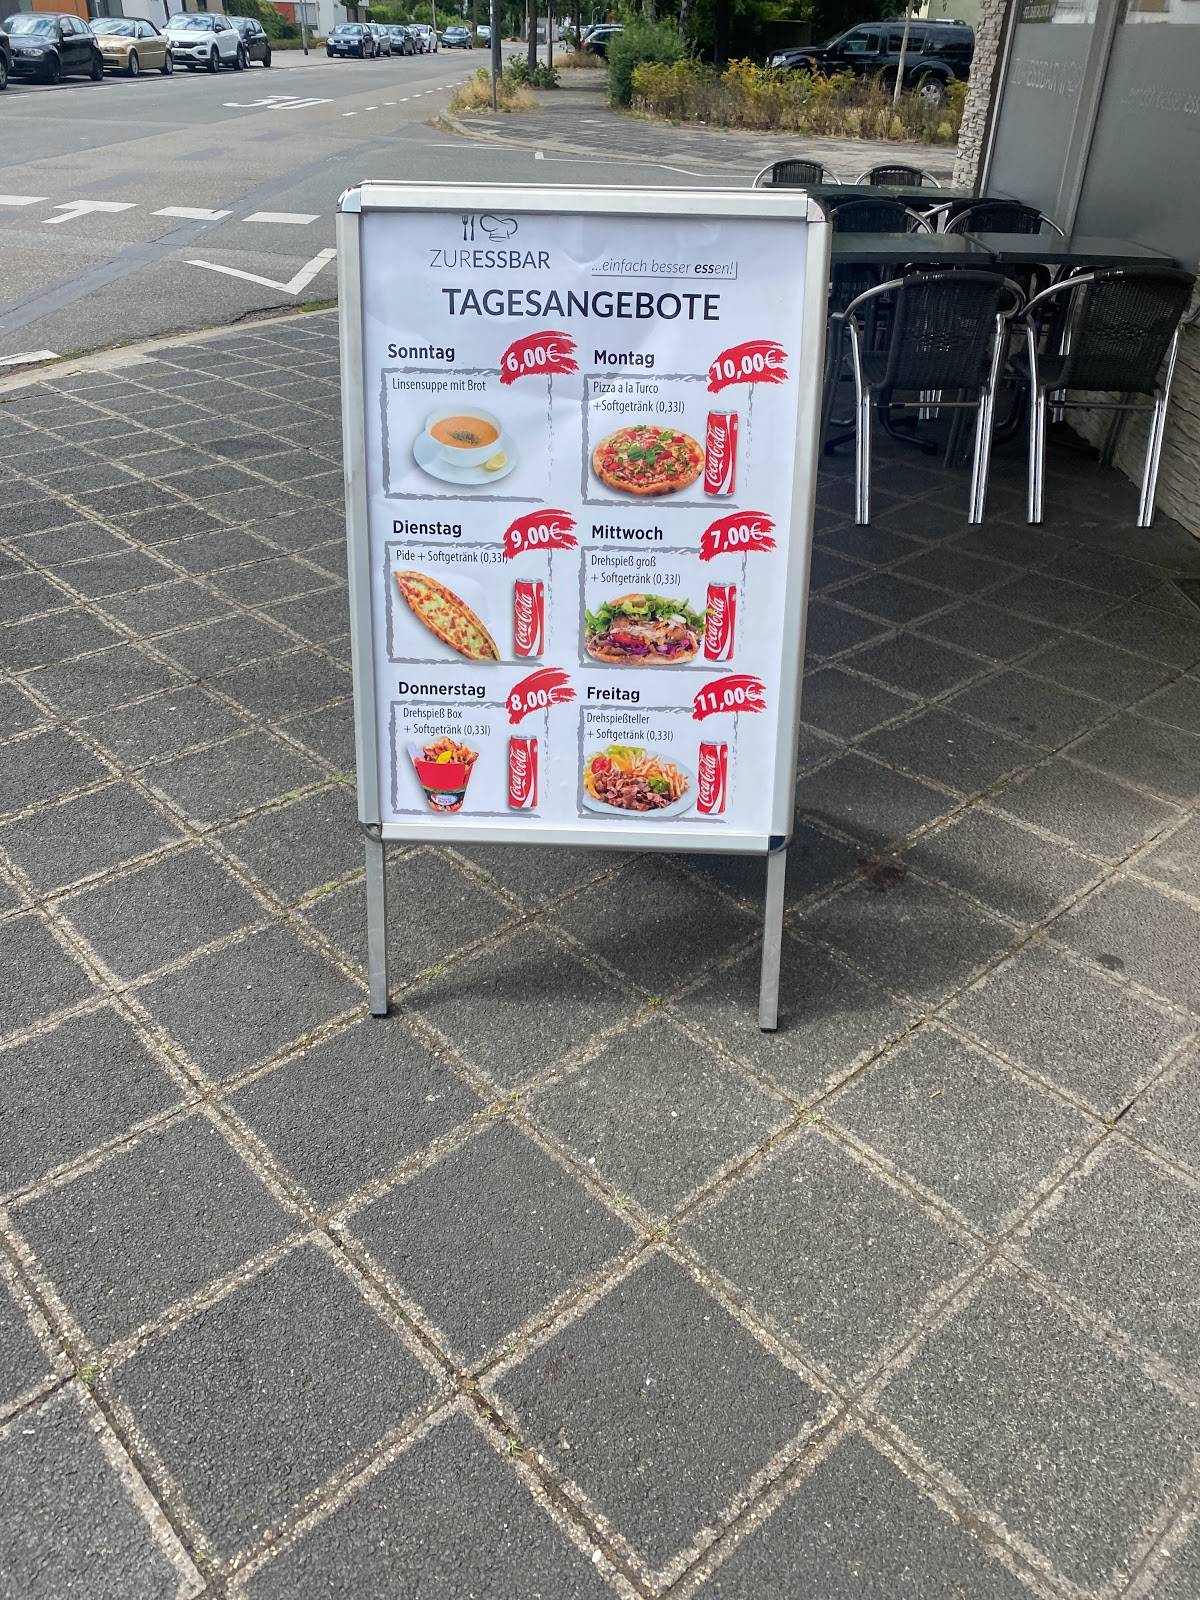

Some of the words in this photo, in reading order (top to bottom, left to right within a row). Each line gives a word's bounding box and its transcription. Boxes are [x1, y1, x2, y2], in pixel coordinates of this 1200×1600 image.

[429, 249, 550, 269] ZURESSBAR
[651, 259, 691, 274] besser
[694, 260, 734, 275] essen!
[441, 288, 721, 321] TAGESANGEBOTE
[387, 343, 455, 362] Sonntag
[507, 343, 560, 373] 6,00€
[594, 350, 655, 368] Montag
[712, 350, 777, 381] 10,00€
[392, 378, 448, 392] Linsensuppe
[450, 379, 466, 391] mit
[467, 380, 487, 391] Brot
[593, 381, 616, 393] Pizza
[617, 384, 623, 393] a
[625, 382, 633, 393] la
[635, 382, 659, 394] Turco
[655, 401, 685, 414] (0,33l)
[393, 520, 462, 538] Dienstag
[511, 522, 563, 549] 9,00€
[592, 525, 663, 540] Mittwoch
[710, 522, 764, 550] 7,00€
[396, 550, 415, 561] Pide
[427, 551, 478, 564] Softgetränk
[591, 555, 634, 568] Drehspieß
[636, 556, 657, 569] groß
[601, 572, 651, 585] Softgetränk
[652, 573, 681, 586] (0,33l)
[398, 681, 486, 698] Donnerstag
[587, 686, 640, 703] Freitag
[510, 687, 561, 712] 8,00€
[697, 685, 757, 712] 11,00€
[403, 707, 445, 720] Drehspieß
[447, 708, 463, 719] Box
[586, 713, 650, 726] Drehspießteller
[413, 723, 462, 736] Softgetränk
[463, 725, 491, 736] (0,33l)
[596, 729, 645, 741] Softgetränk
[646, 730, 674, 742] (0,33l)
